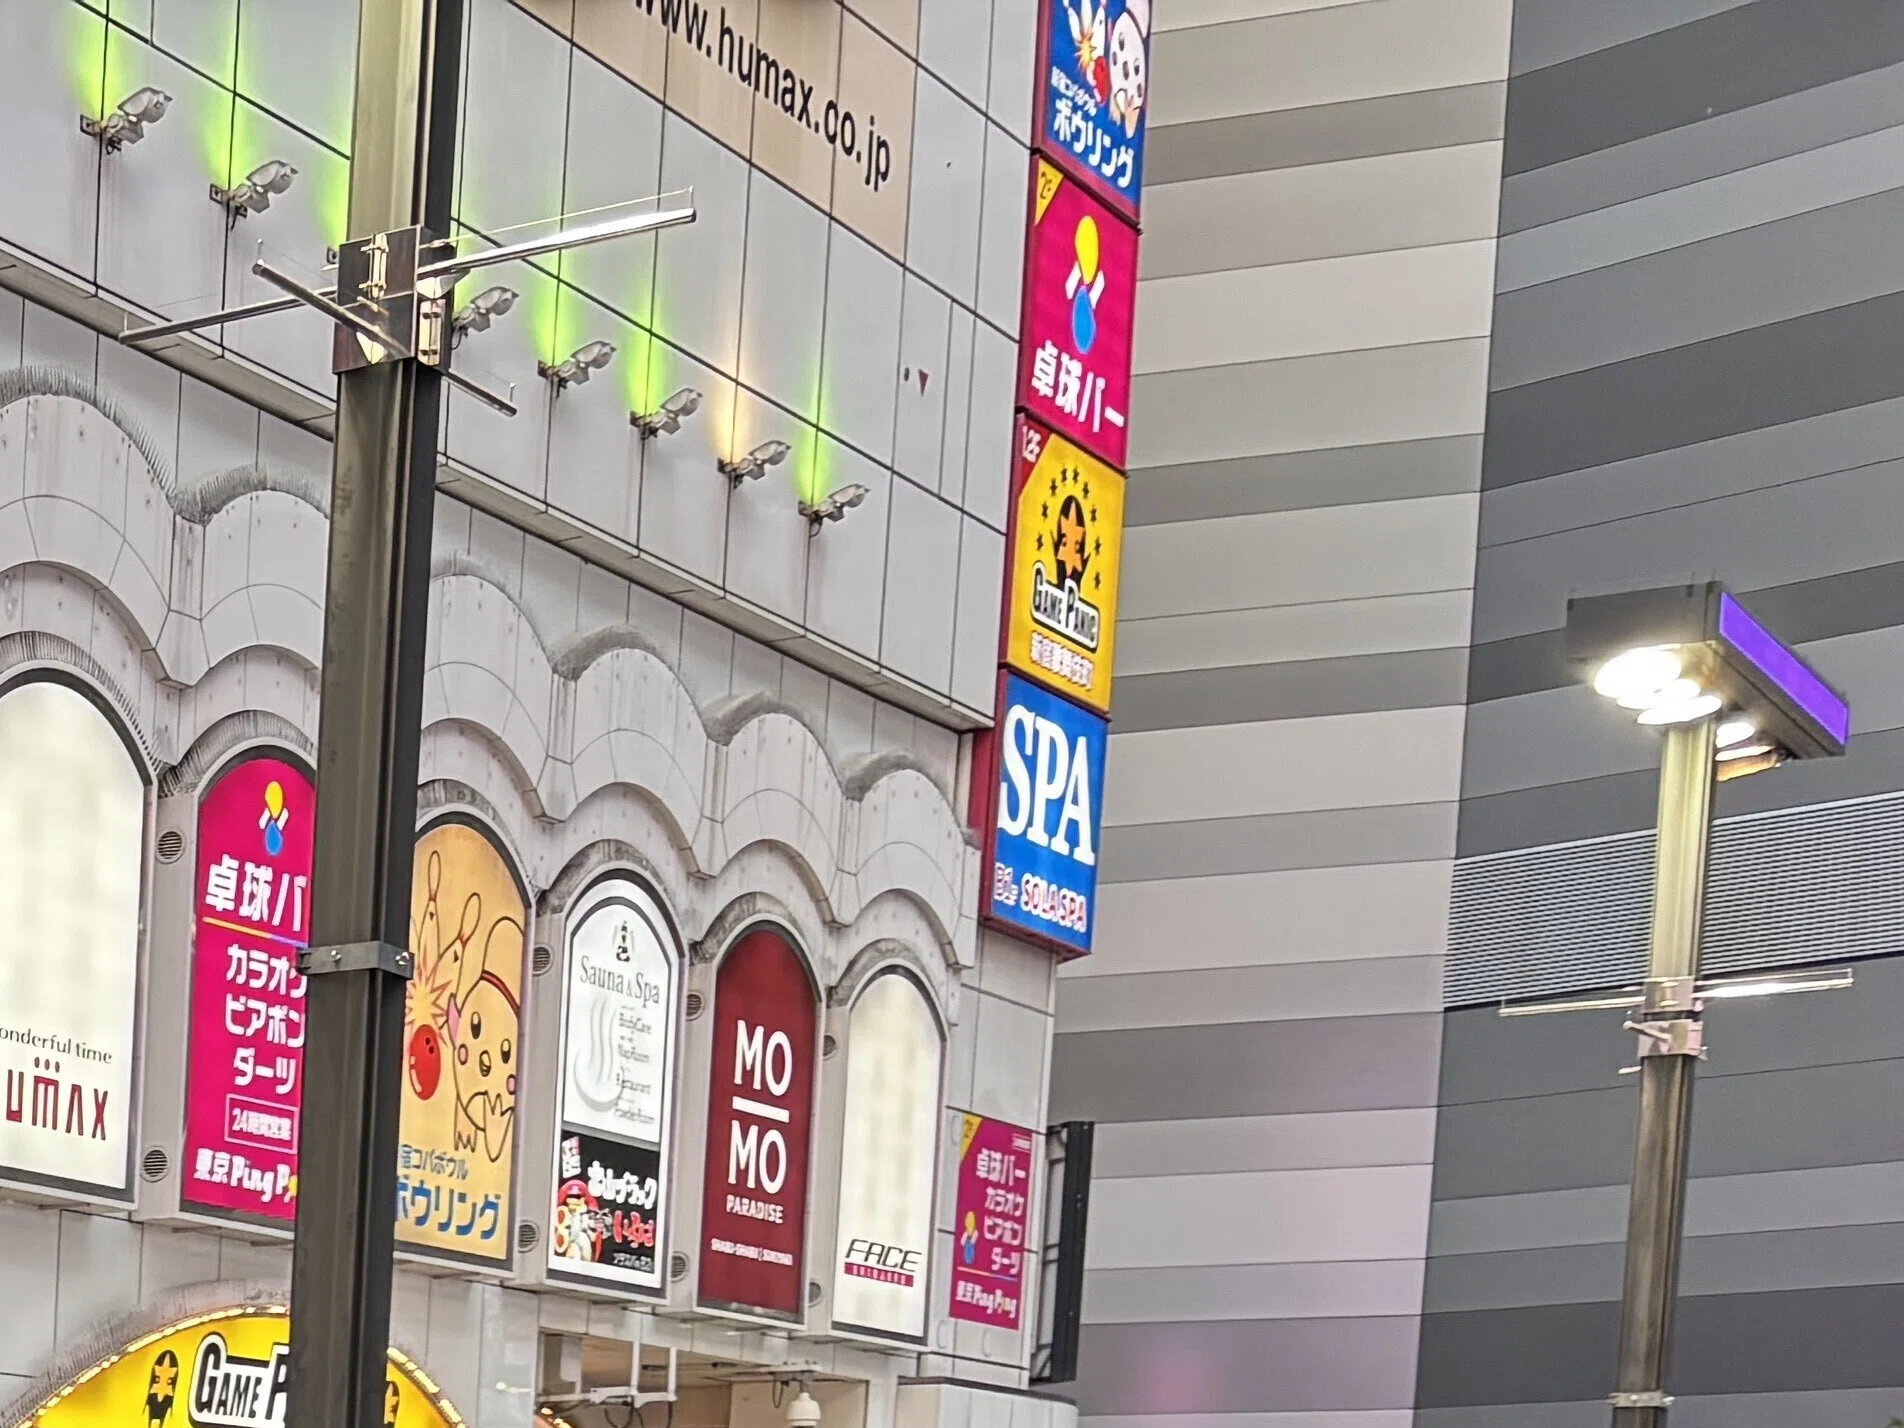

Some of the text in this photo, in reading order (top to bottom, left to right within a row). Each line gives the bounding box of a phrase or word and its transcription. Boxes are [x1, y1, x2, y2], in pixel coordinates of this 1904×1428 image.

[636, 0, 891, 191] ww.humax.co.jp
[1053, 97, 1134, 188] ボウリング
[1030, 340, 1125, 433] 卓球バー
[996, 703, 1096, 866] SPA
[204, 853, 309, 932] 卓球バ
[580, 955, 624, 994] Sauna
[635, 972, 661, 1009] Spa
[75, 1041, 113, 1065] time
[232, 1047, 297, 1095] ダーツ
[732, 1019, 793, 1097] MO
[727, 1119, 788, 1195] MO
[726, 1194, 784, 1225] PARADISE
[845, 1238, 923, 1274] FACE
[196, 1342, 263, 1419] GAME
